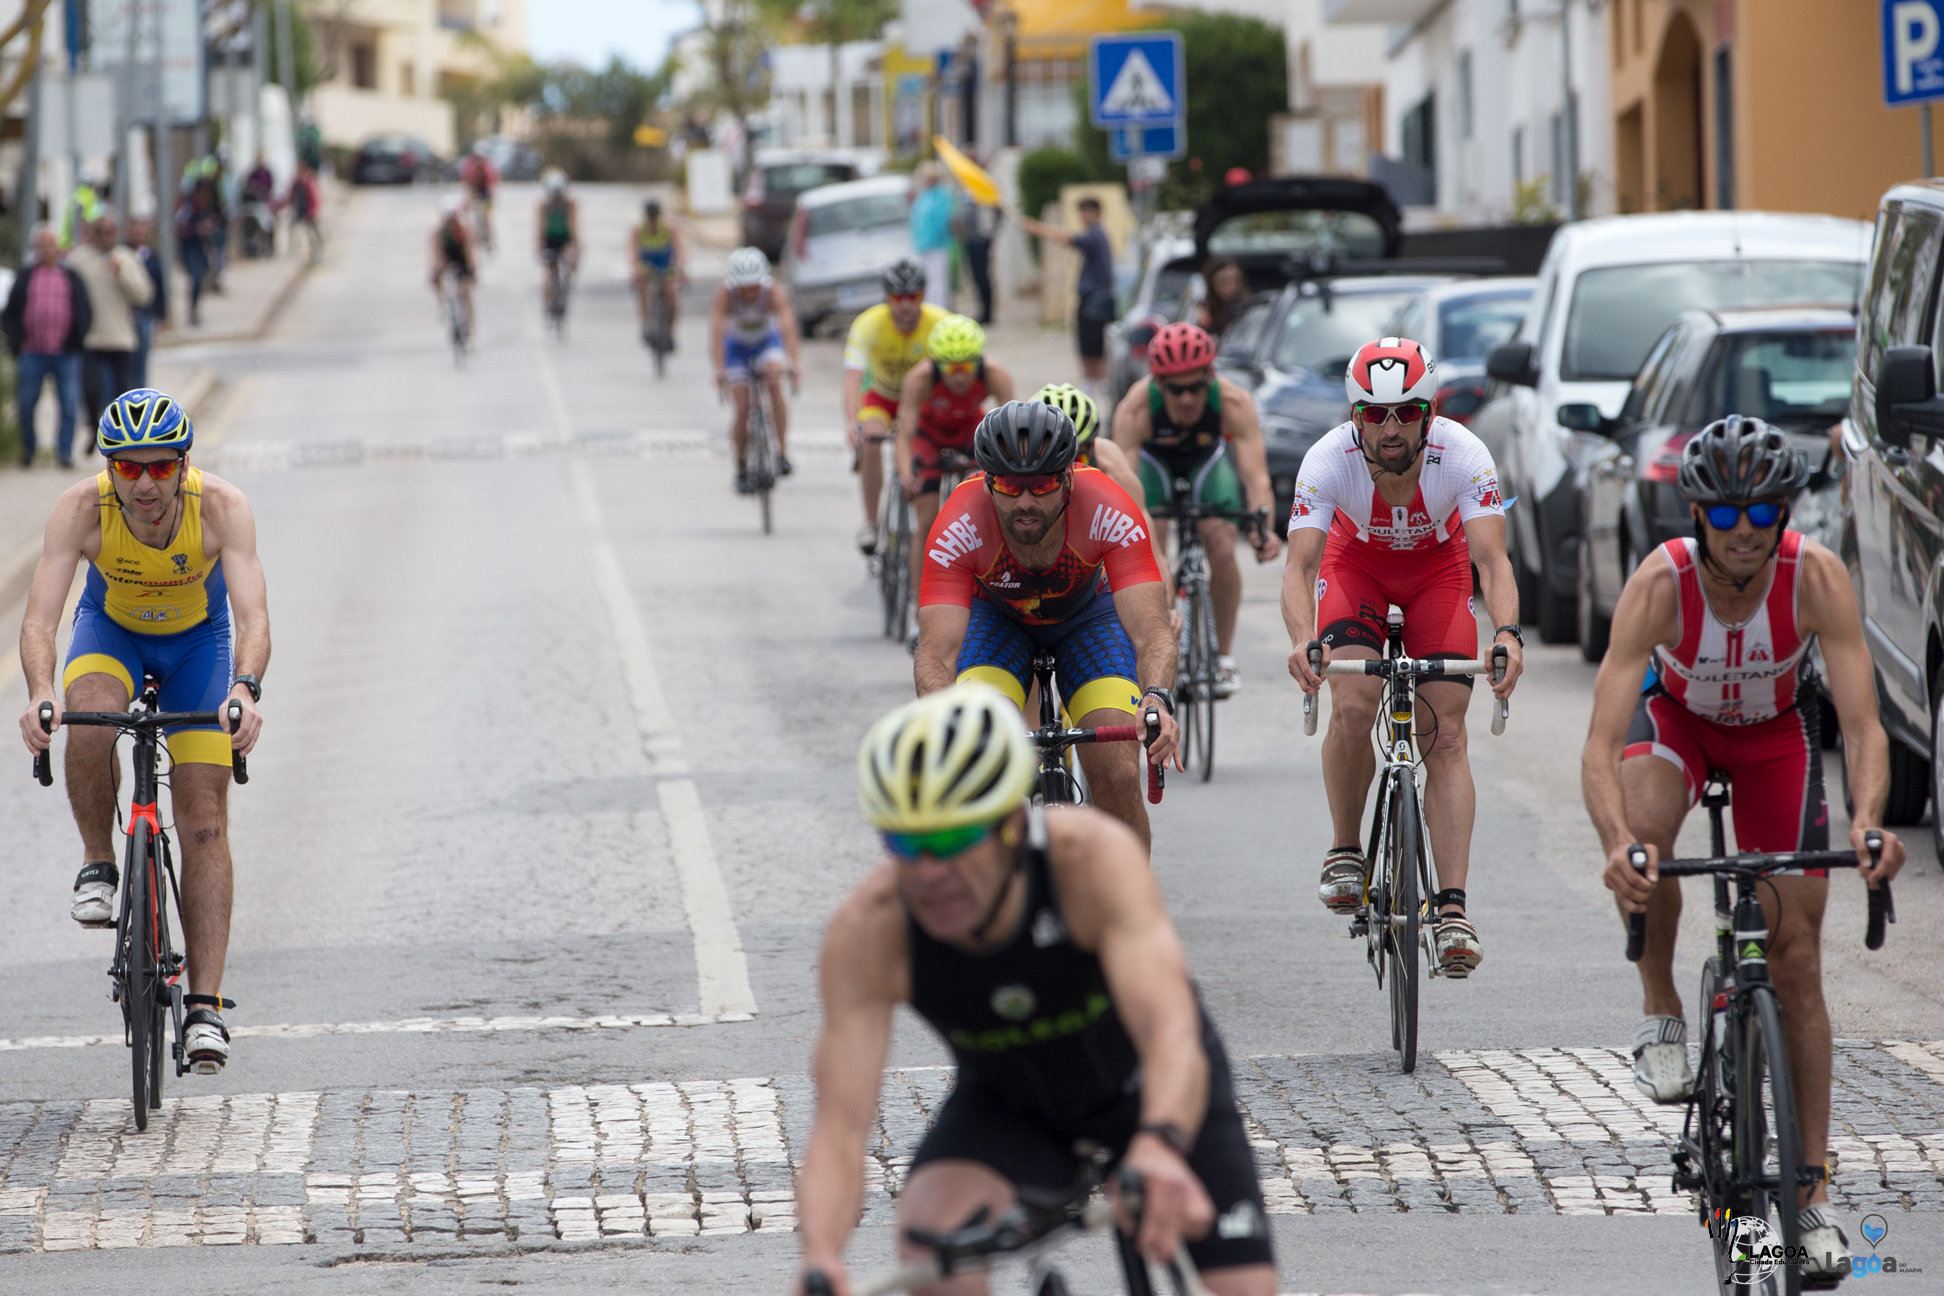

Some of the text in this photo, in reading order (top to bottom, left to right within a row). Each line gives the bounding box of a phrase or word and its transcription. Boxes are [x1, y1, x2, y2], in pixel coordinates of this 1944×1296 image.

[1893, 1, 1941, 95] P
[928, 512, 984, 568] AHBE
[1089, 504, 1146, 547] AHBE
[1672, 660, 1792, 682] LOULETANO
[81, 869, 99, 878] GIRO
